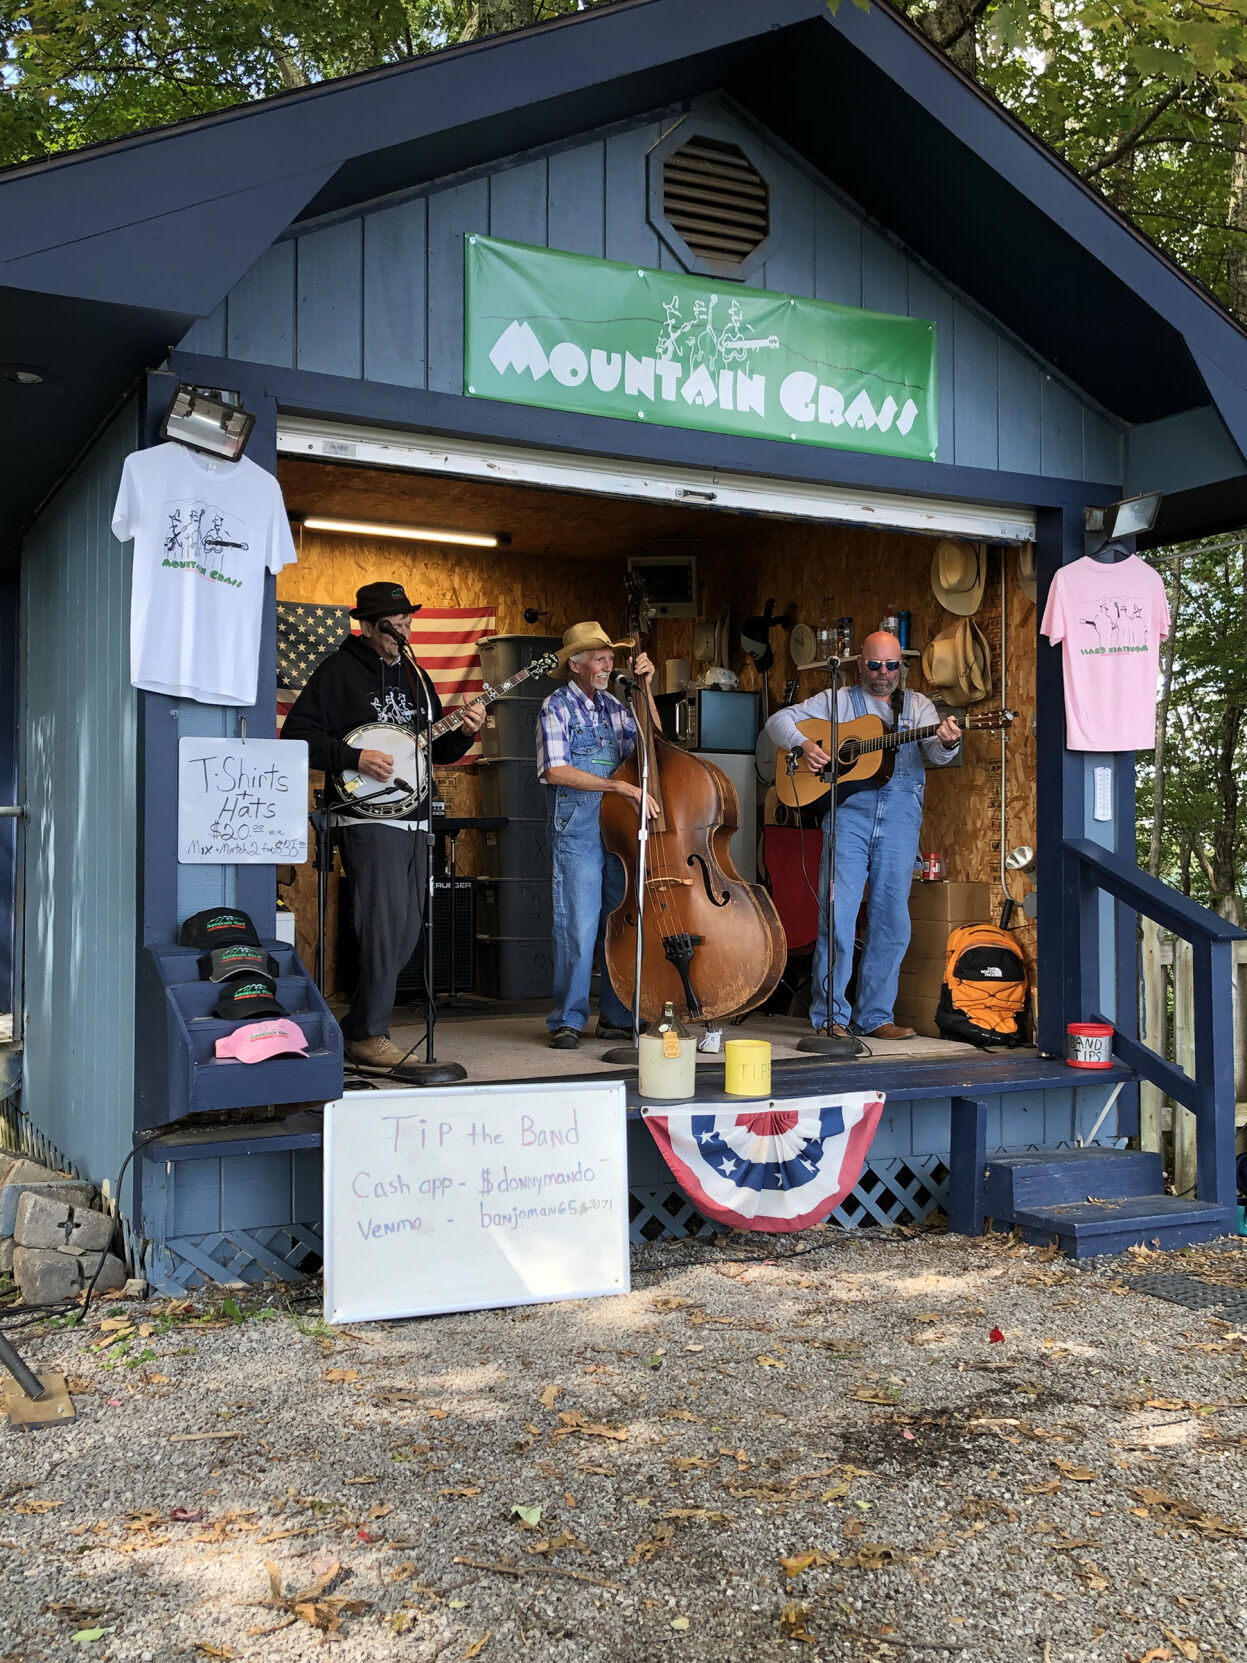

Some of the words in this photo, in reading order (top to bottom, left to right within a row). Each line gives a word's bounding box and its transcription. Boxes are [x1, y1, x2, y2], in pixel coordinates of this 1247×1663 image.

[488, 320, 766, 418] MOUNTAIN
[779, 370, 919, 436] GRASS
[218, 796, 276, 822] Hats
[1073, 1048, 1102, 1062] TIPS
[467, 1122, 505, 1147] the
[352, 1171, 411, 1199] Cash
